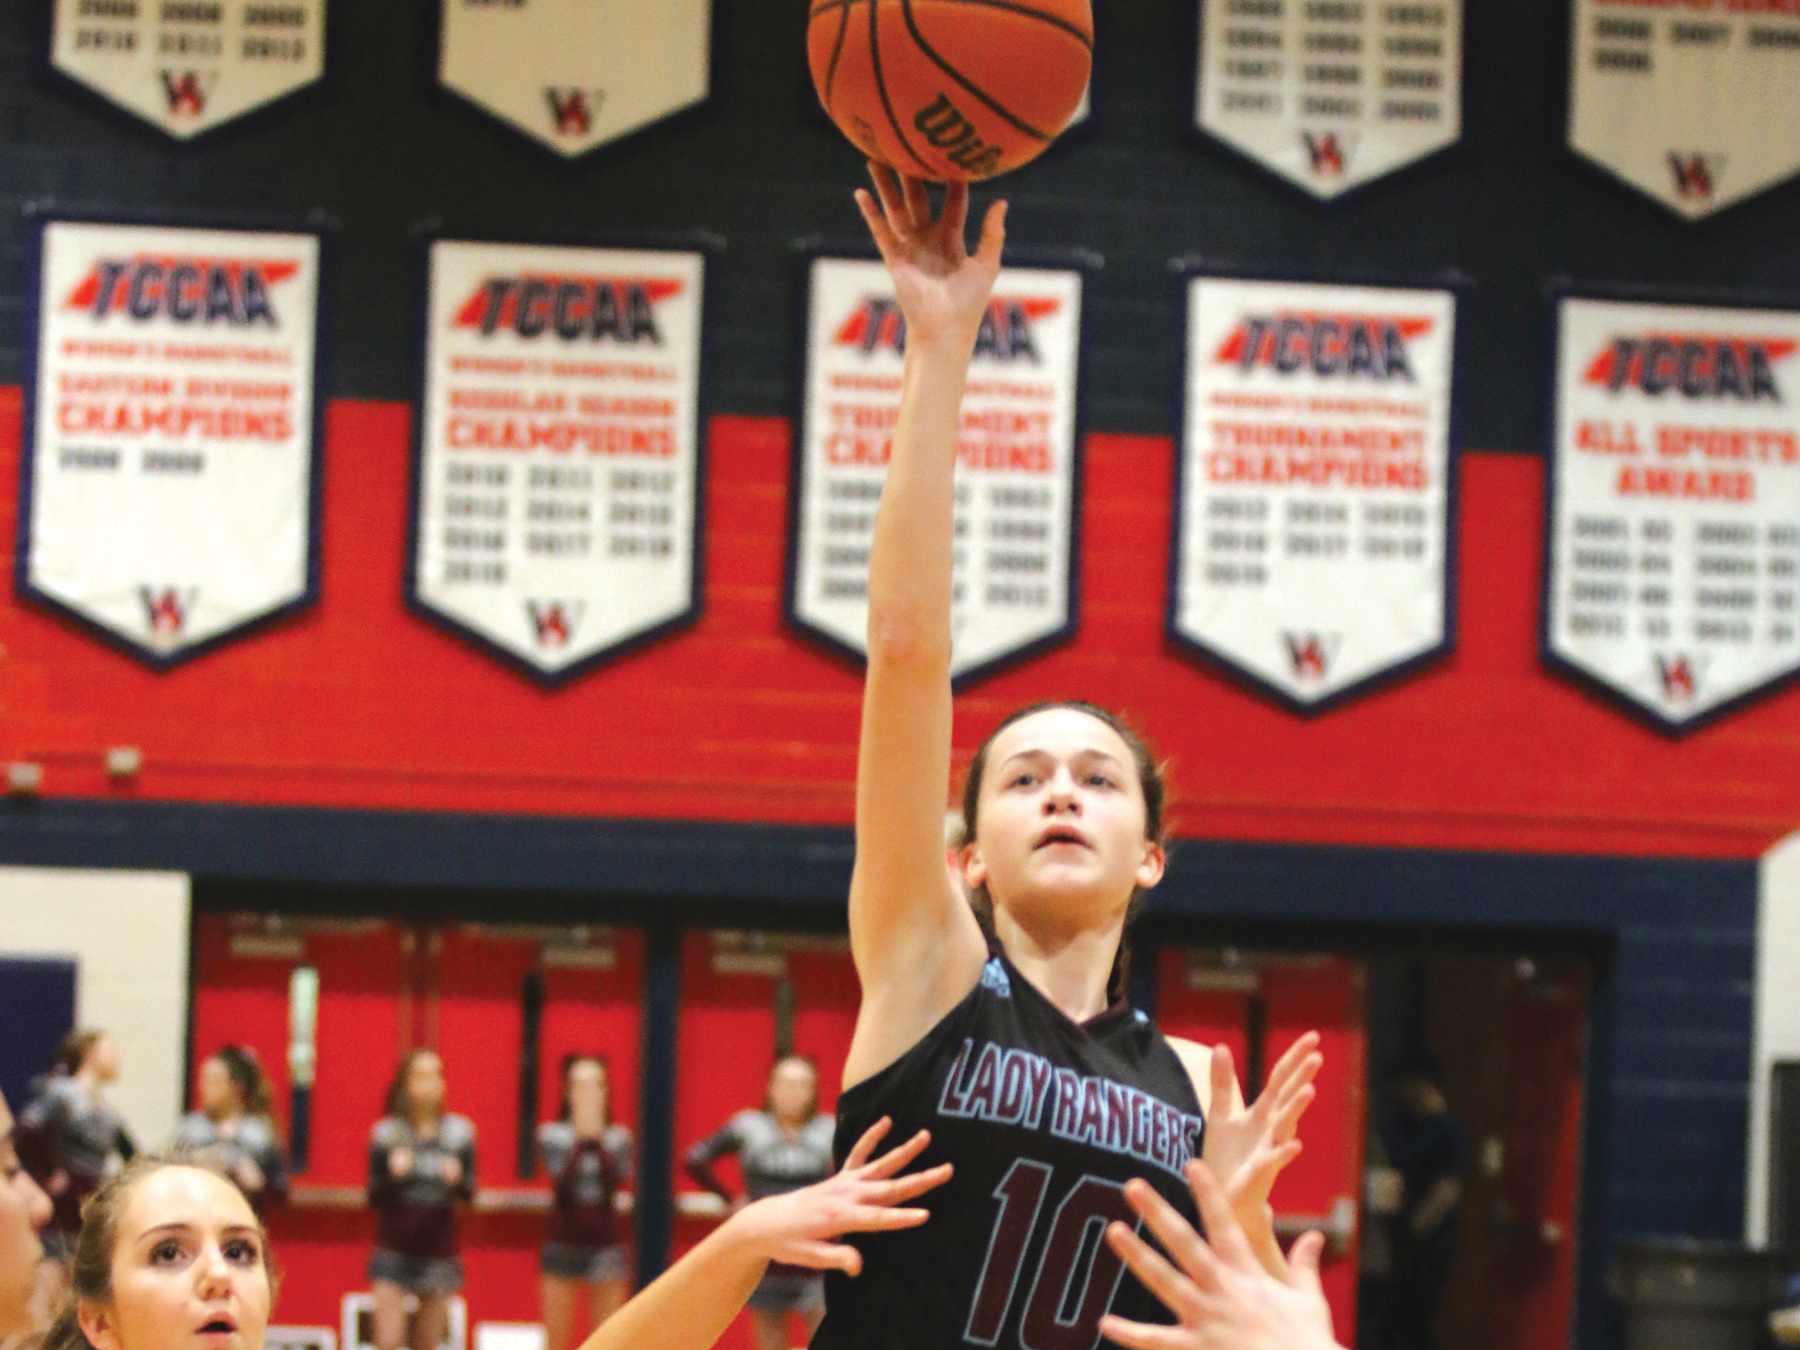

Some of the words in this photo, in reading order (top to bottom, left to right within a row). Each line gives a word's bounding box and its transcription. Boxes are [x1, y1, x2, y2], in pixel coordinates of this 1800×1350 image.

[914, 93, 1003, 174] Wil
[88, 260, 280, 330] TCCAA
[478, 276, 664, 347] TCCAA
[862, 296, 1042, 365] TAA
[1240, 315, 1418, 381] TCCAA
[1608, 337, 1785, 404] TCCAA
[57, 401, 292, 443] CHAMPIONS
[446, 415, 677, 459] CHAMPIONS
[1207, 420, 1426, 453] TOURNAMENT
[1575, 419, 1639, 454] ALL
[1655, 425, 1799, 463] SPORTS
[1206, 453, 1428, 491] CHAMPIONS
[1616, 465, 1755, 502] AWARD
[937, 1037, 1050, 1130] LADY
[1051, 1066, 1203, 1184] RANGERS
